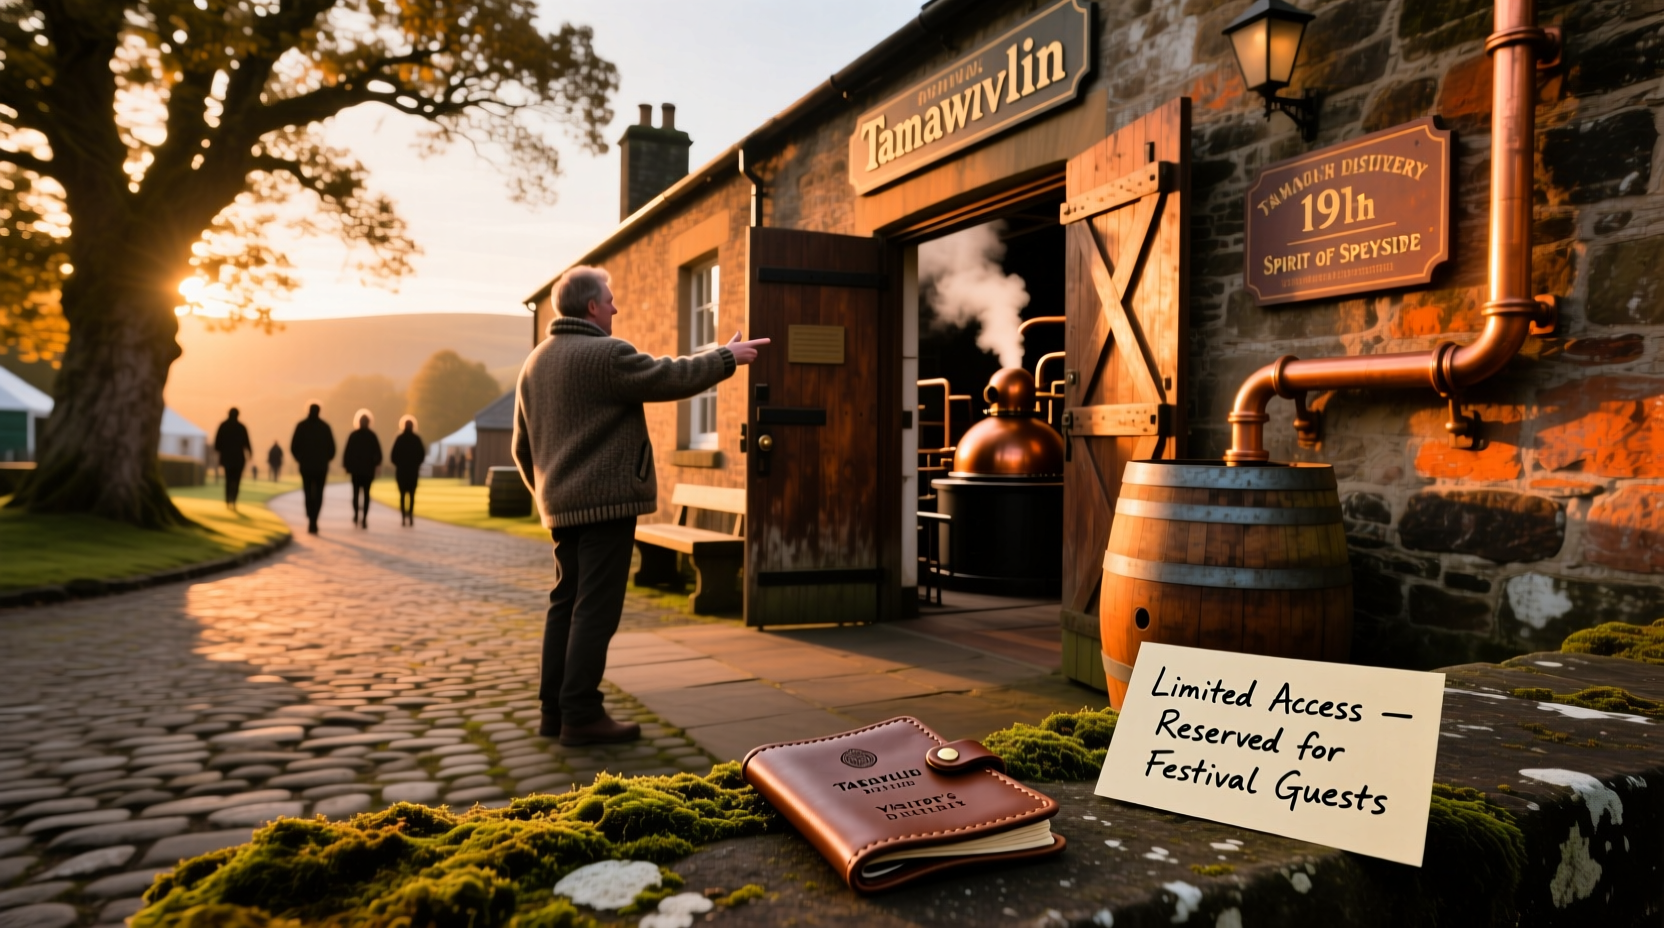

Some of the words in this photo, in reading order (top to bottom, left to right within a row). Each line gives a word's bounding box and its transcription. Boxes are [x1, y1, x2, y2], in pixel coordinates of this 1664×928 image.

[1264, 252, 1310, 275] SPIRIT
[1315, 248, 1335, 267] OF
[1339, 233, 1421, 263] SPEYSIDE
[1152, 667, 1257, 707] Limited
[1269, 683, 1362, 721] Access
[1155, 709, 1283, 753] Reserved
[1297, 731, 1345, 761] for
[1146, 750, 1259, 793] Festival
[1276, 770, 1387, 814] Guests
